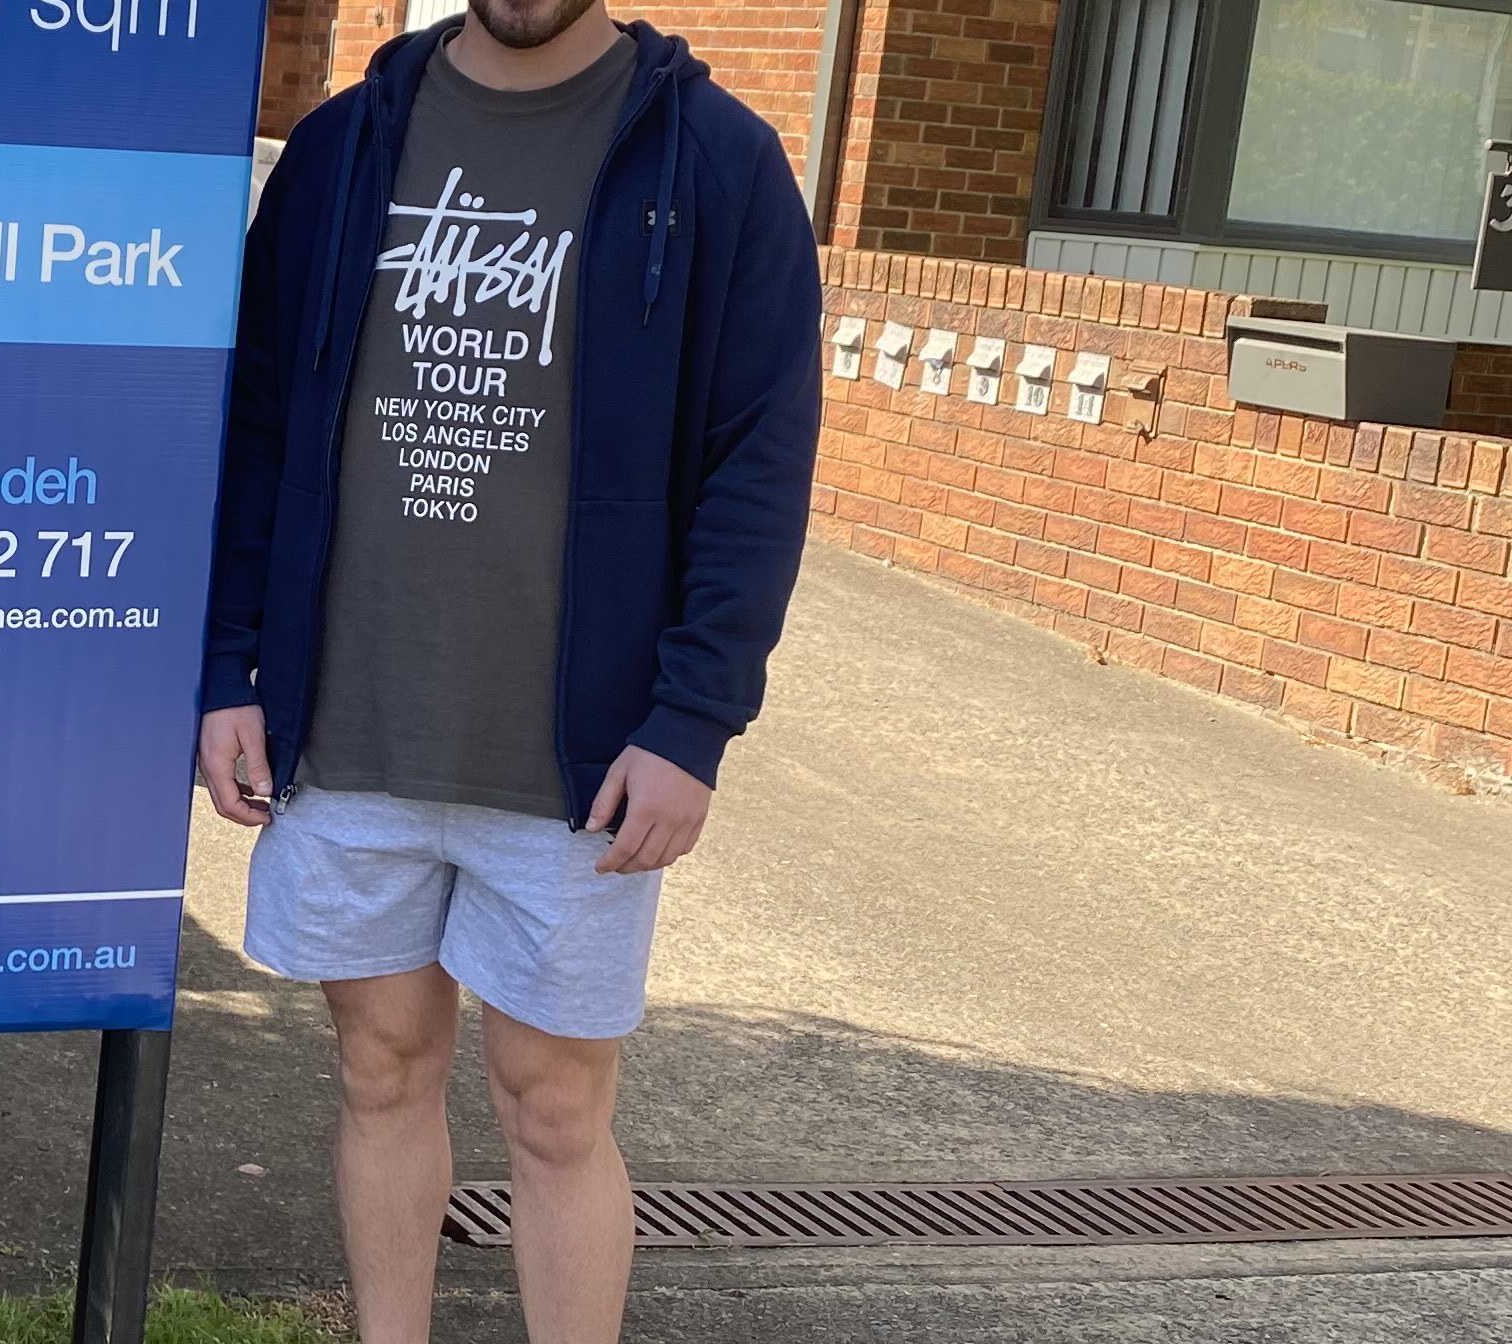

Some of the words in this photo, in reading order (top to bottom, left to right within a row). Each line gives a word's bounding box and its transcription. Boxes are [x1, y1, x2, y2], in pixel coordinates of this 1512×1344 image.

[40, 223, 184, 287] Park
[402, 323, 530, 362] WORLD
[412, 361, 508, 398] TOUR
[374, 396, 419, 418] NEW
[424, 399, 487, 425] YORK
[492, 405, 547, 428] CITY
[1024, 384, 1045, 408] 10
[1075, 392, 1095, 417] 11
[381, 421, 418, 443] LOS
[422, 424, 530, 453] ANGELES
[398, 447, 492, 475] LONDON
[409, 473, 475, 498] PARIS
[401, 497, 478, 523] TOKYO
[37, 531, 135, 578] 717
